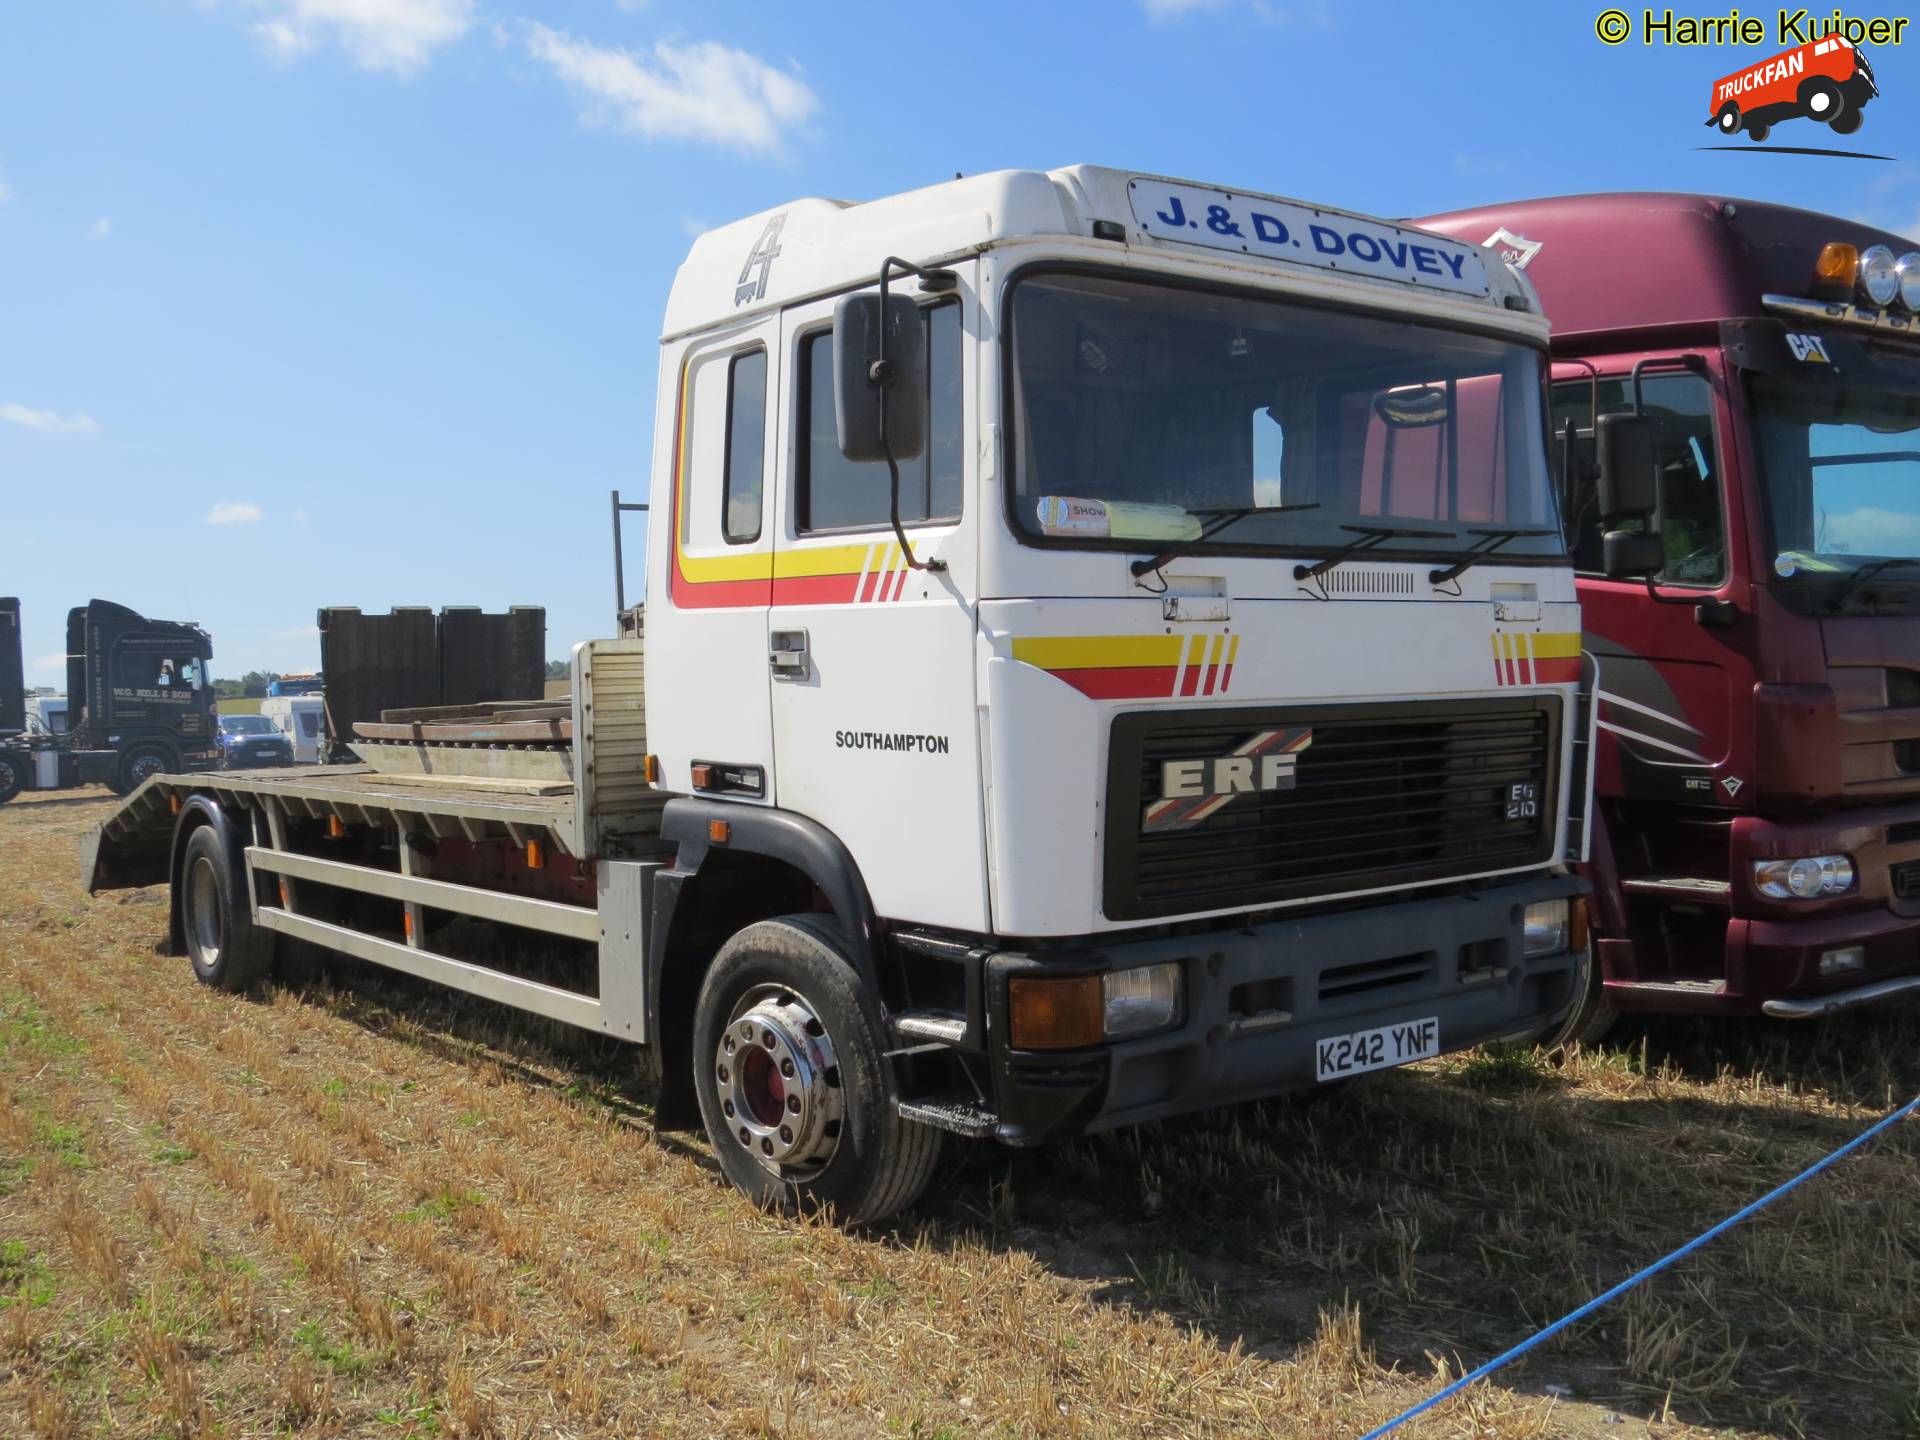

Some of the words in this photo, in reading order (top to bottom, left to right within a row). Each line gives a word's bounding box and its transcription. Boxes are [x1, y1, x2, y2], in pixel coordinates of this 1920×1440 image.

[1156, 196, 1198, 230] J.
[1206, 204, 1246, 239] &
[1250, 212, 1301, 248] D.
[1309, 224, 1466, 280] DOVEY
[1785, 333, 1831, 363] CAT
[1072, 505, 1106, 518] SHOW
[136, 689, 160, 698] HILL
[171, 690, 192, 699] SON
[835, 730, 949, 754] SOUTHAMPTON
[1162, 753, 1298, 799] ERF
[1507, 800, 1536, 818] 210
[1319, 1033, 1385, 1075] K242
[1391, 1021, 1436, 1058] YNF
